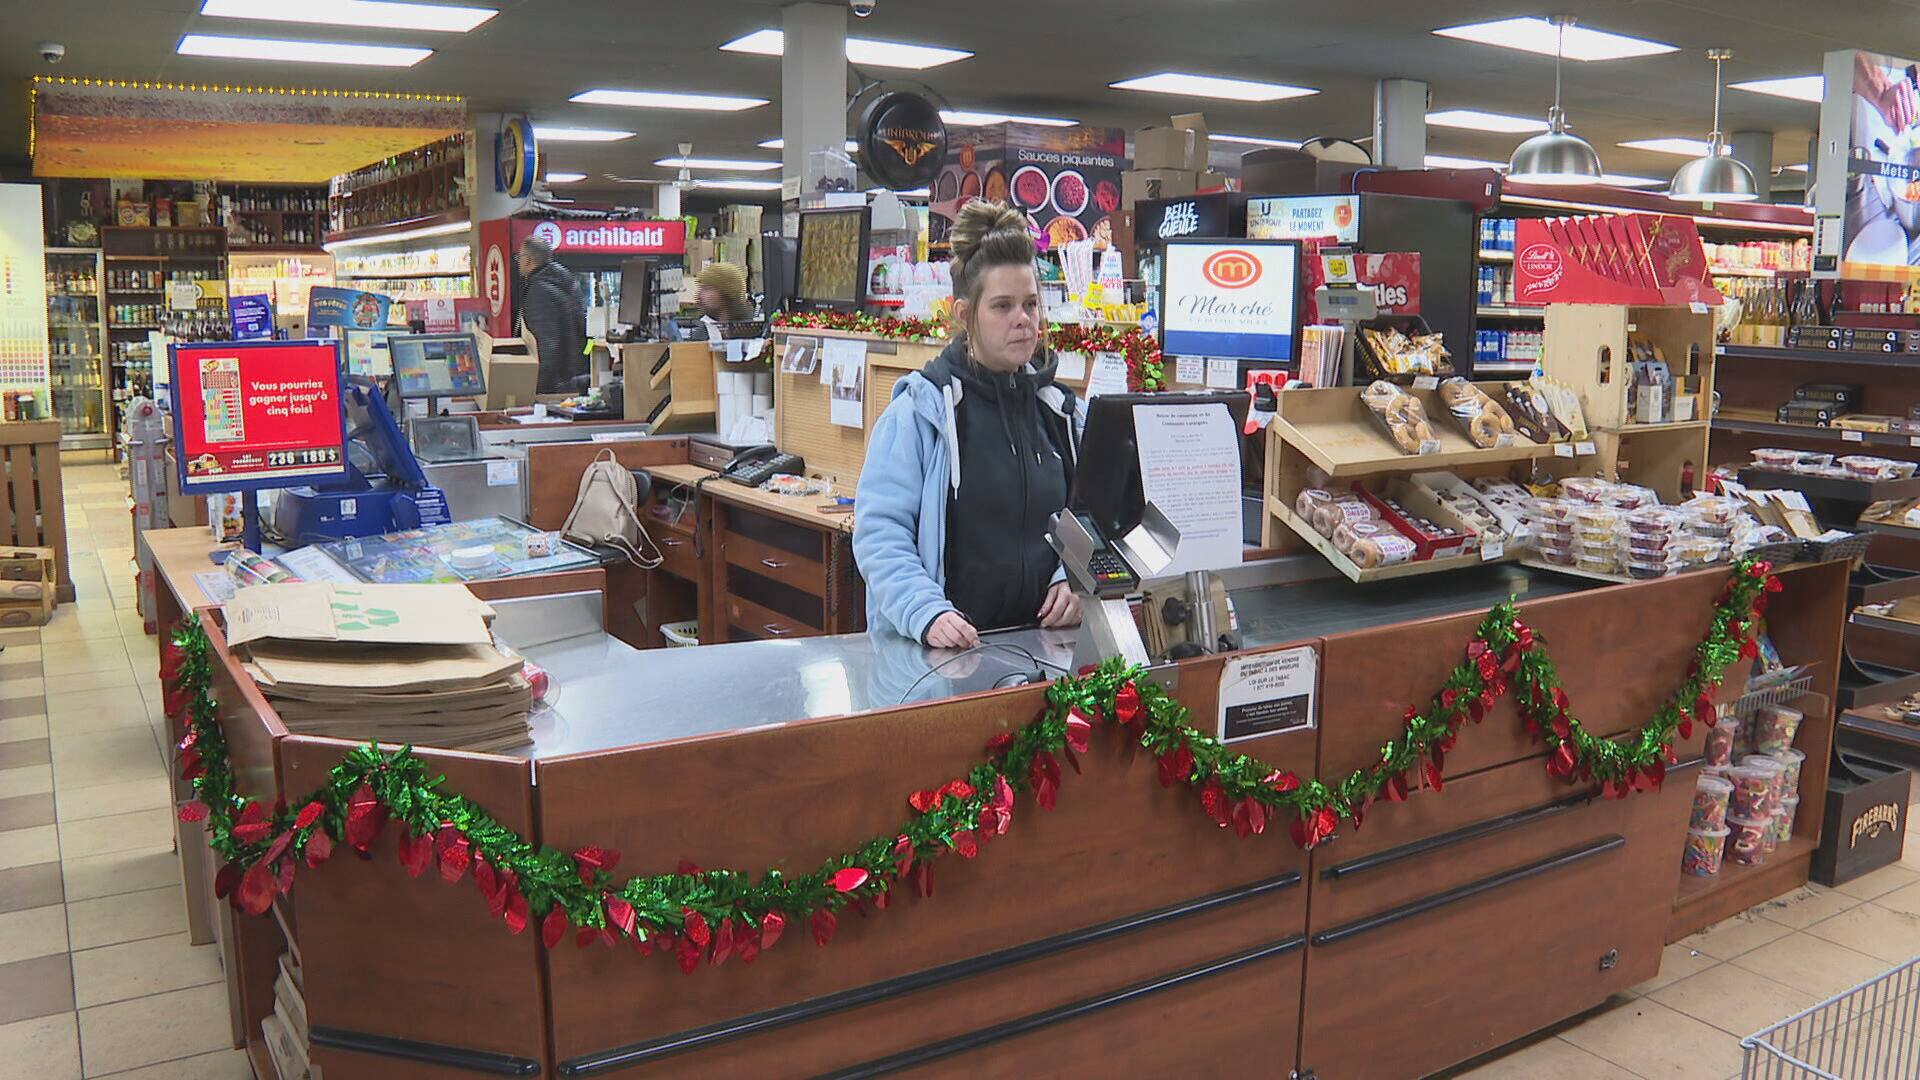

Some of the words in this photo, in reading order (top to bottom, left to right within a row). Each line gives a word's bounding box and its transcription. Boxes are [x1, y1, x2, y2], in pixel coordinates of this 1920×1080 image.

[1018, 149, 1060, 164] Sauces
[1061, 153, 1115, 168] piquantes
[1880, 162, 1909, 178] Mets
[1164, 201, 1196, 221] BELLE
[1292, 208, 1323, 219] PARTAGEZ
[1158, 214, 1200, 239] GUEULE
[1289, 221, 1298, 231] LE
[1300, 220, 1324, 232] MOMENT
[566, 226, 664, 247] archibald
[1526, 262, 1553, 271] LINDOR
[1178, 294, 1273, 316] Marché
[251, 381, 278, 391] Vous
[279, 380, 324, 392] pourriez
[249, 393, 287, 407] gagner
[288, 390, 328, 403] jusqu'à
[266, 406, 289, 417] cinq
[290, 405, 313, 415] fois!
[1850, 801, 1899, 849] FIREBARNS
